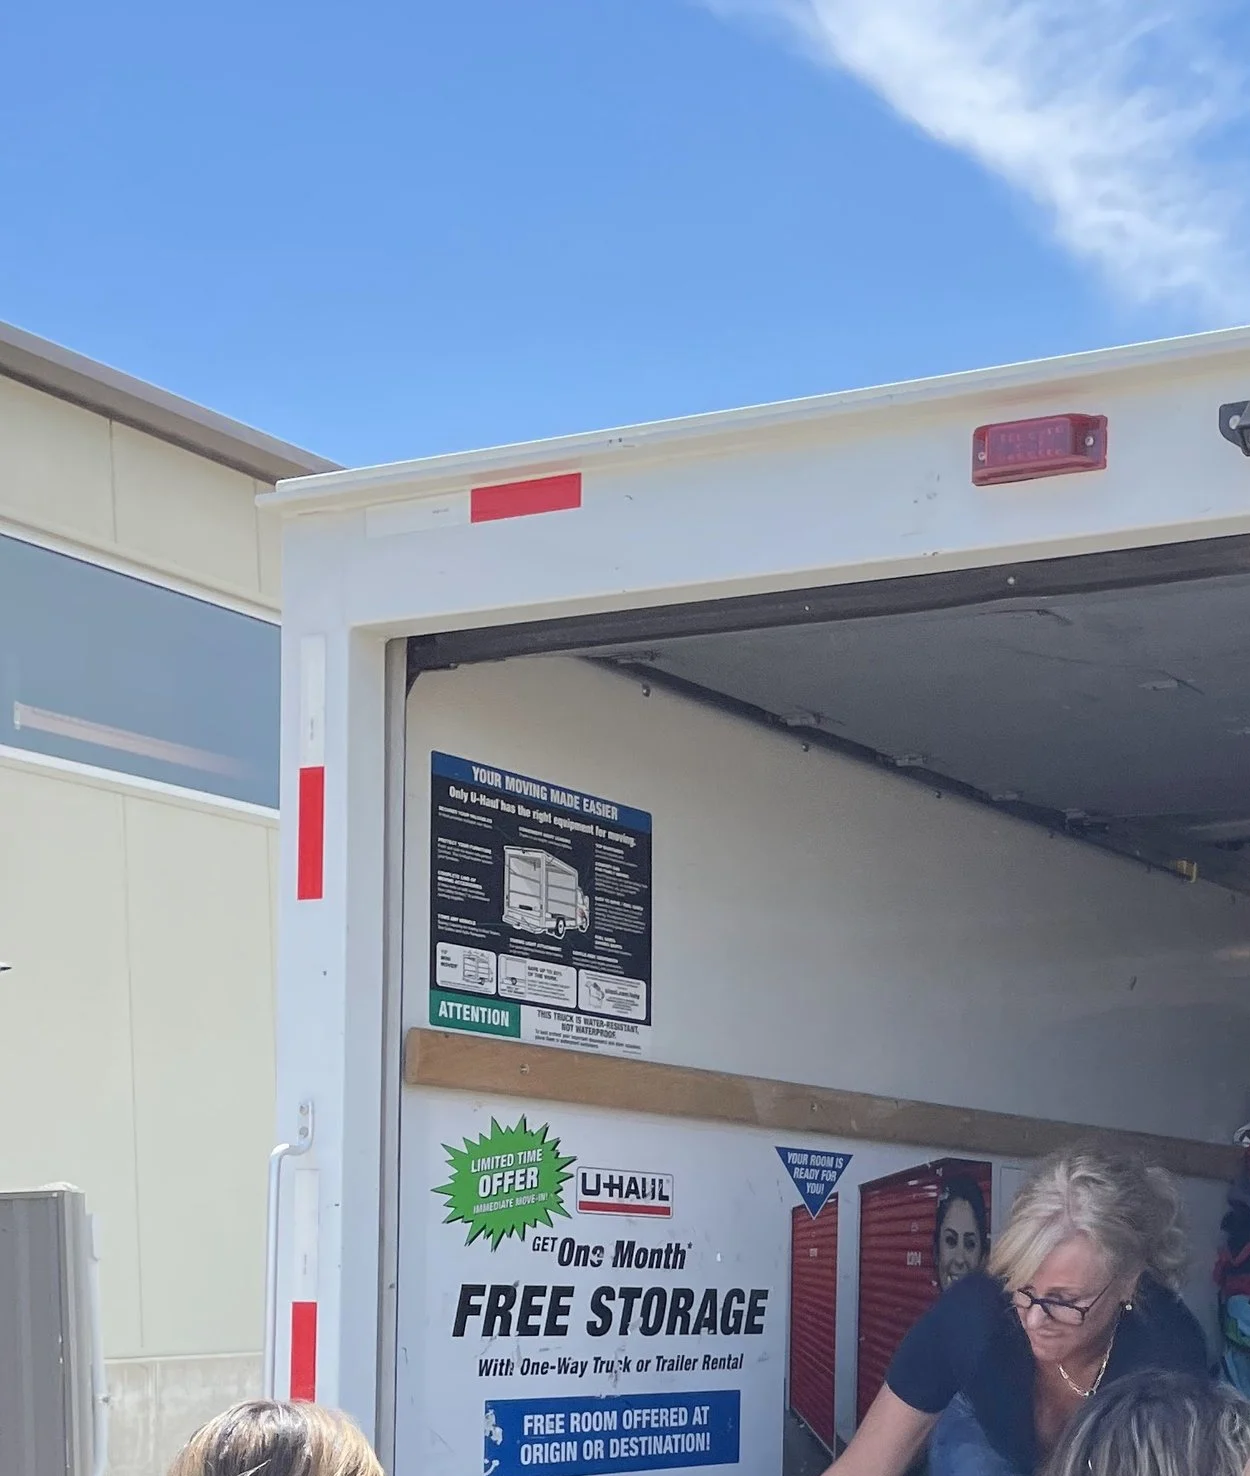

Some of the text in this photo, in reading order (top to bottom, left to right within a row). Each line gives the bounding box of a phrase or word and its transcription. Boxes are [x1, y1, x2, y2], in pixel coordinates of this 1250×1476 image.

[472, 766, 618, 820] YOUR MOVING MADE EASIER
[449, 786, 468, 803] Only
[500, 800, 516, 814] has
[517, 805, 531, 817] the
[532, 810, 551, 824] right
[553, 816, 594, 835] equipment
[595, 825, 606, 838] for
[607, 831, 636, 848] moving.
[438, 1000, 510, 1028] ATTENTION
[537, 1010, 551, 1020] THIS
[554, 1012, 574, 1023] TRUCK
[575, 1016, 582, 1025] IS
[561, 1023, 574, 1032] NOT
[471, 1149, 543, 1173] LIMITED TIME
[787, 1151, 844, 1169] YOUR ROOM IS
[478, 1166, 540, 1198] OFFER
[581, 1172, 670, 1202] U-HAUL
[793, 1167, 837, 1182] READY FOR
[806, 1182, 825, 1195] YOU!
[473, 1192, 549, 1214] IMMEDIATE MOVE-IN!
[532, 1236, 558, 1252] GET
[557, 1237, 604, 1268] One
[452, 1283, 769, 1337] FREE STORAGE
[478, 1358, 514, 1377] With
[520, 1357, 588, 1378] One-Way
[636, 1359, 651, 1373] or
[656, 1355, 699, 1371] Trailer
[702, 1353, 744, 1370] Rental
[523, 1406, 710, 1436] FREE ROOM OFFERED AT
[521, 1432, 711, 1466] ORIGIN OR DESTINATION!
